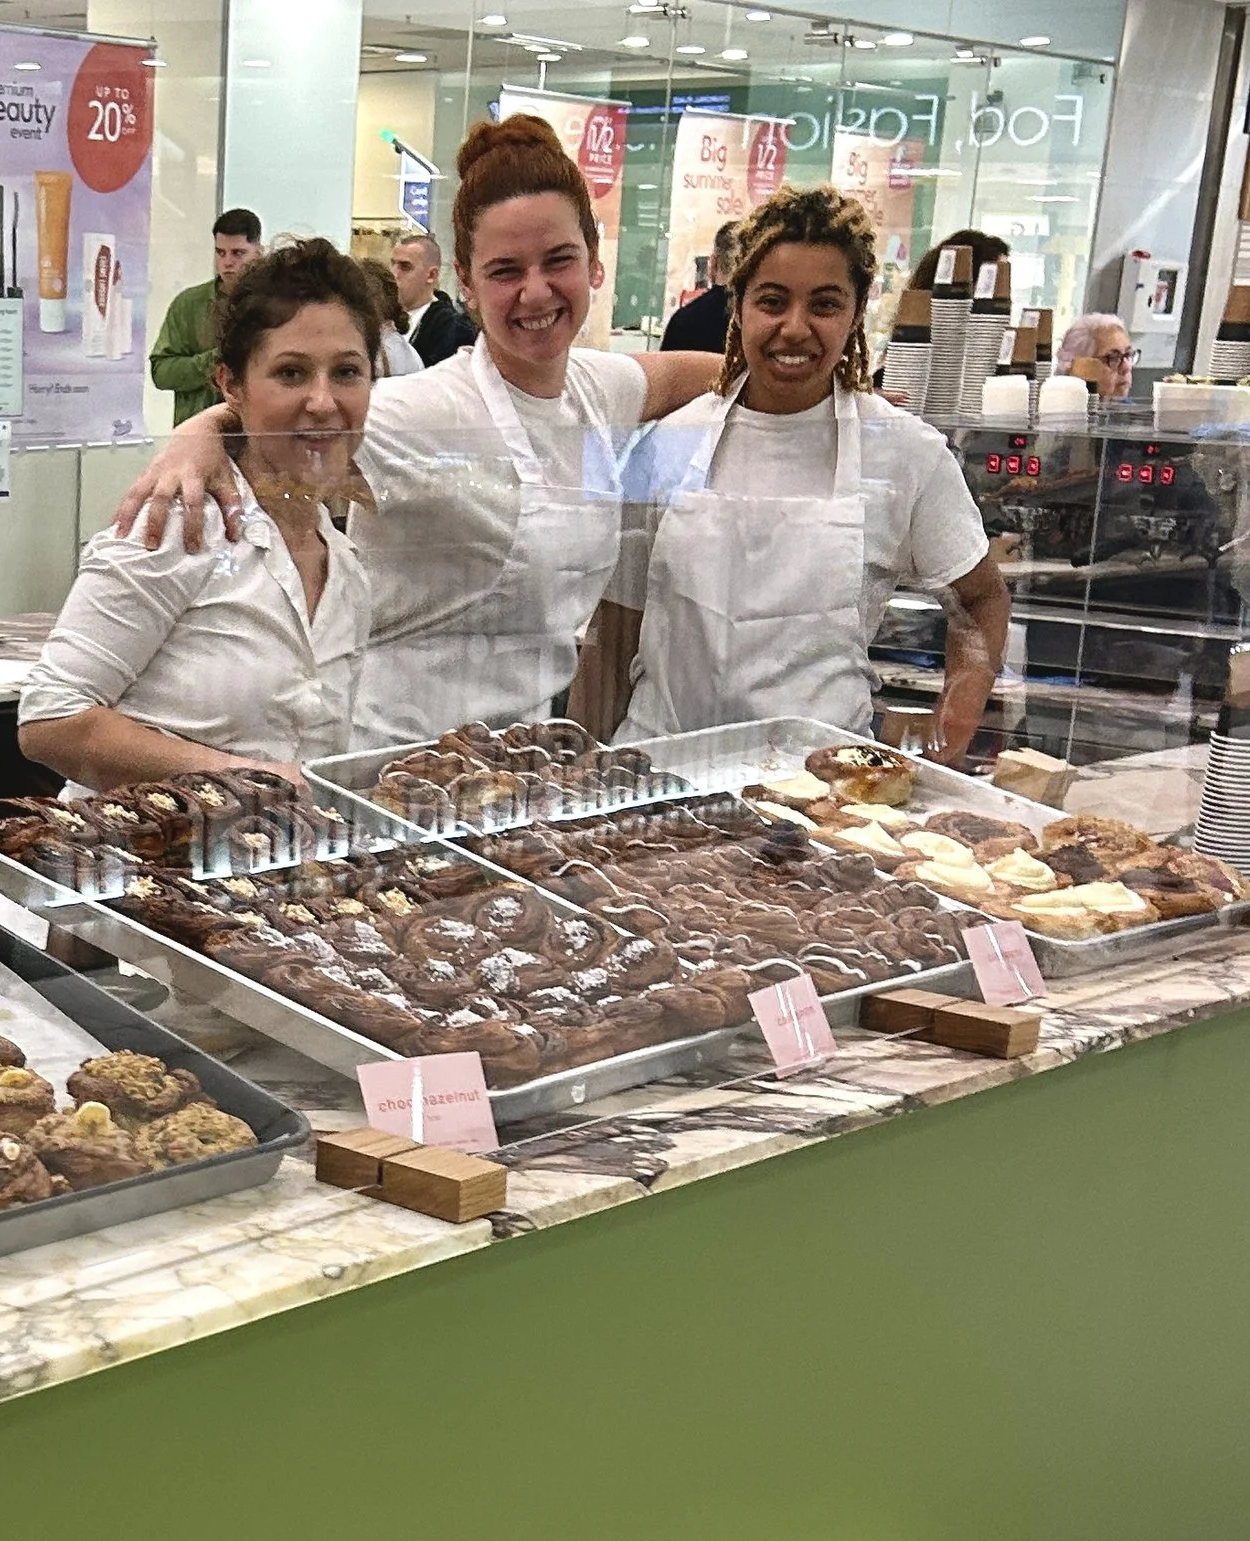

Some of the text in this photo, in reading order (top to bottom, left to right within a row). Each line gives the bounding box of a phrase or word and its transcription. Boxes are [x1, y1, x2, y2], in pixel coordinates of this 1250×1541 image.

[95, 85, 130, 100] UP TO
[87, 100, 137, 142] 20%
[9, 126, 43, 140] event
[700, 135, 728, 172] Big
[683, 173, 734, 190] summer
[716, 189, 744, 215] sale
